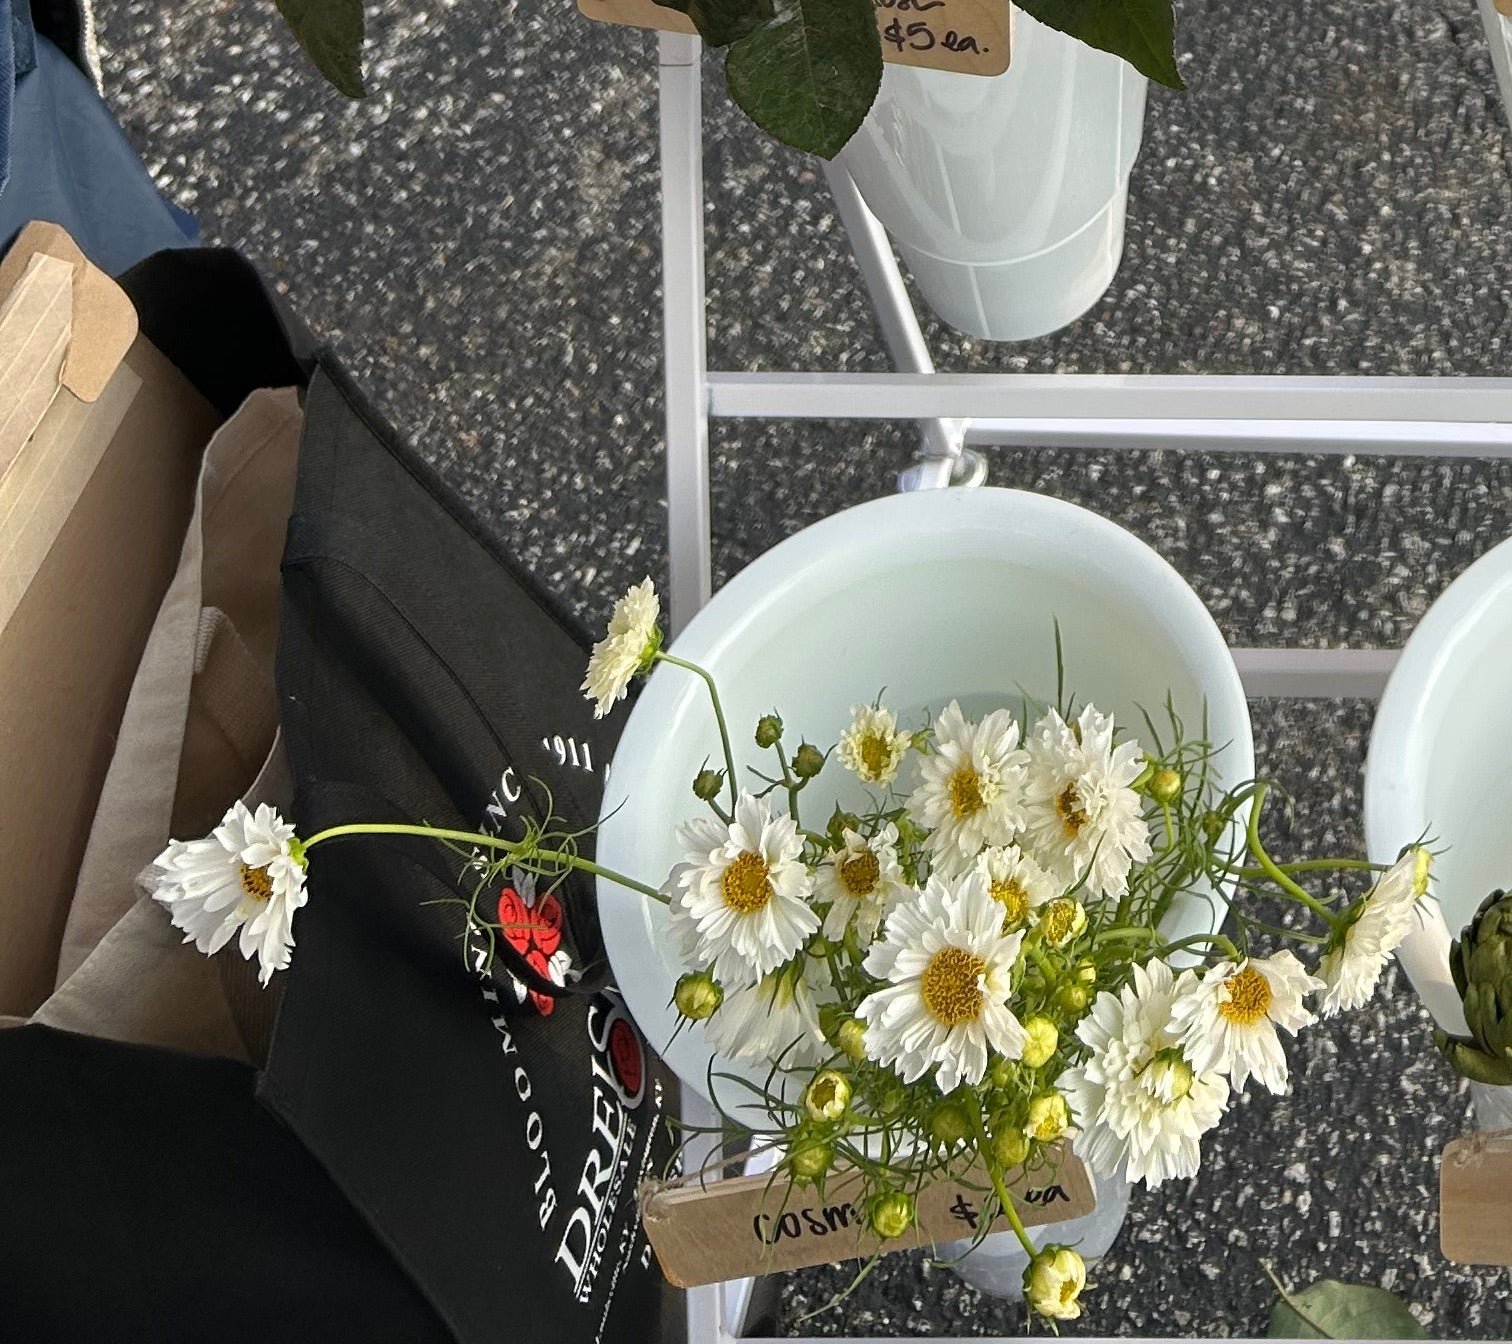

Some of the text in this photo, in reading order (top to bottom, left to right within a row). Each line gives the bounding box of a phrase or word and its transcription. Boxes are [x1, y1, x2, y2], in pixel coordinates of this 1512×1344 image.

[554, 988, 647, 1296] DREIS
[576, 1115, 638, 1304] WHOLESALE
[752, 1201, 864, 1246] Cosm
